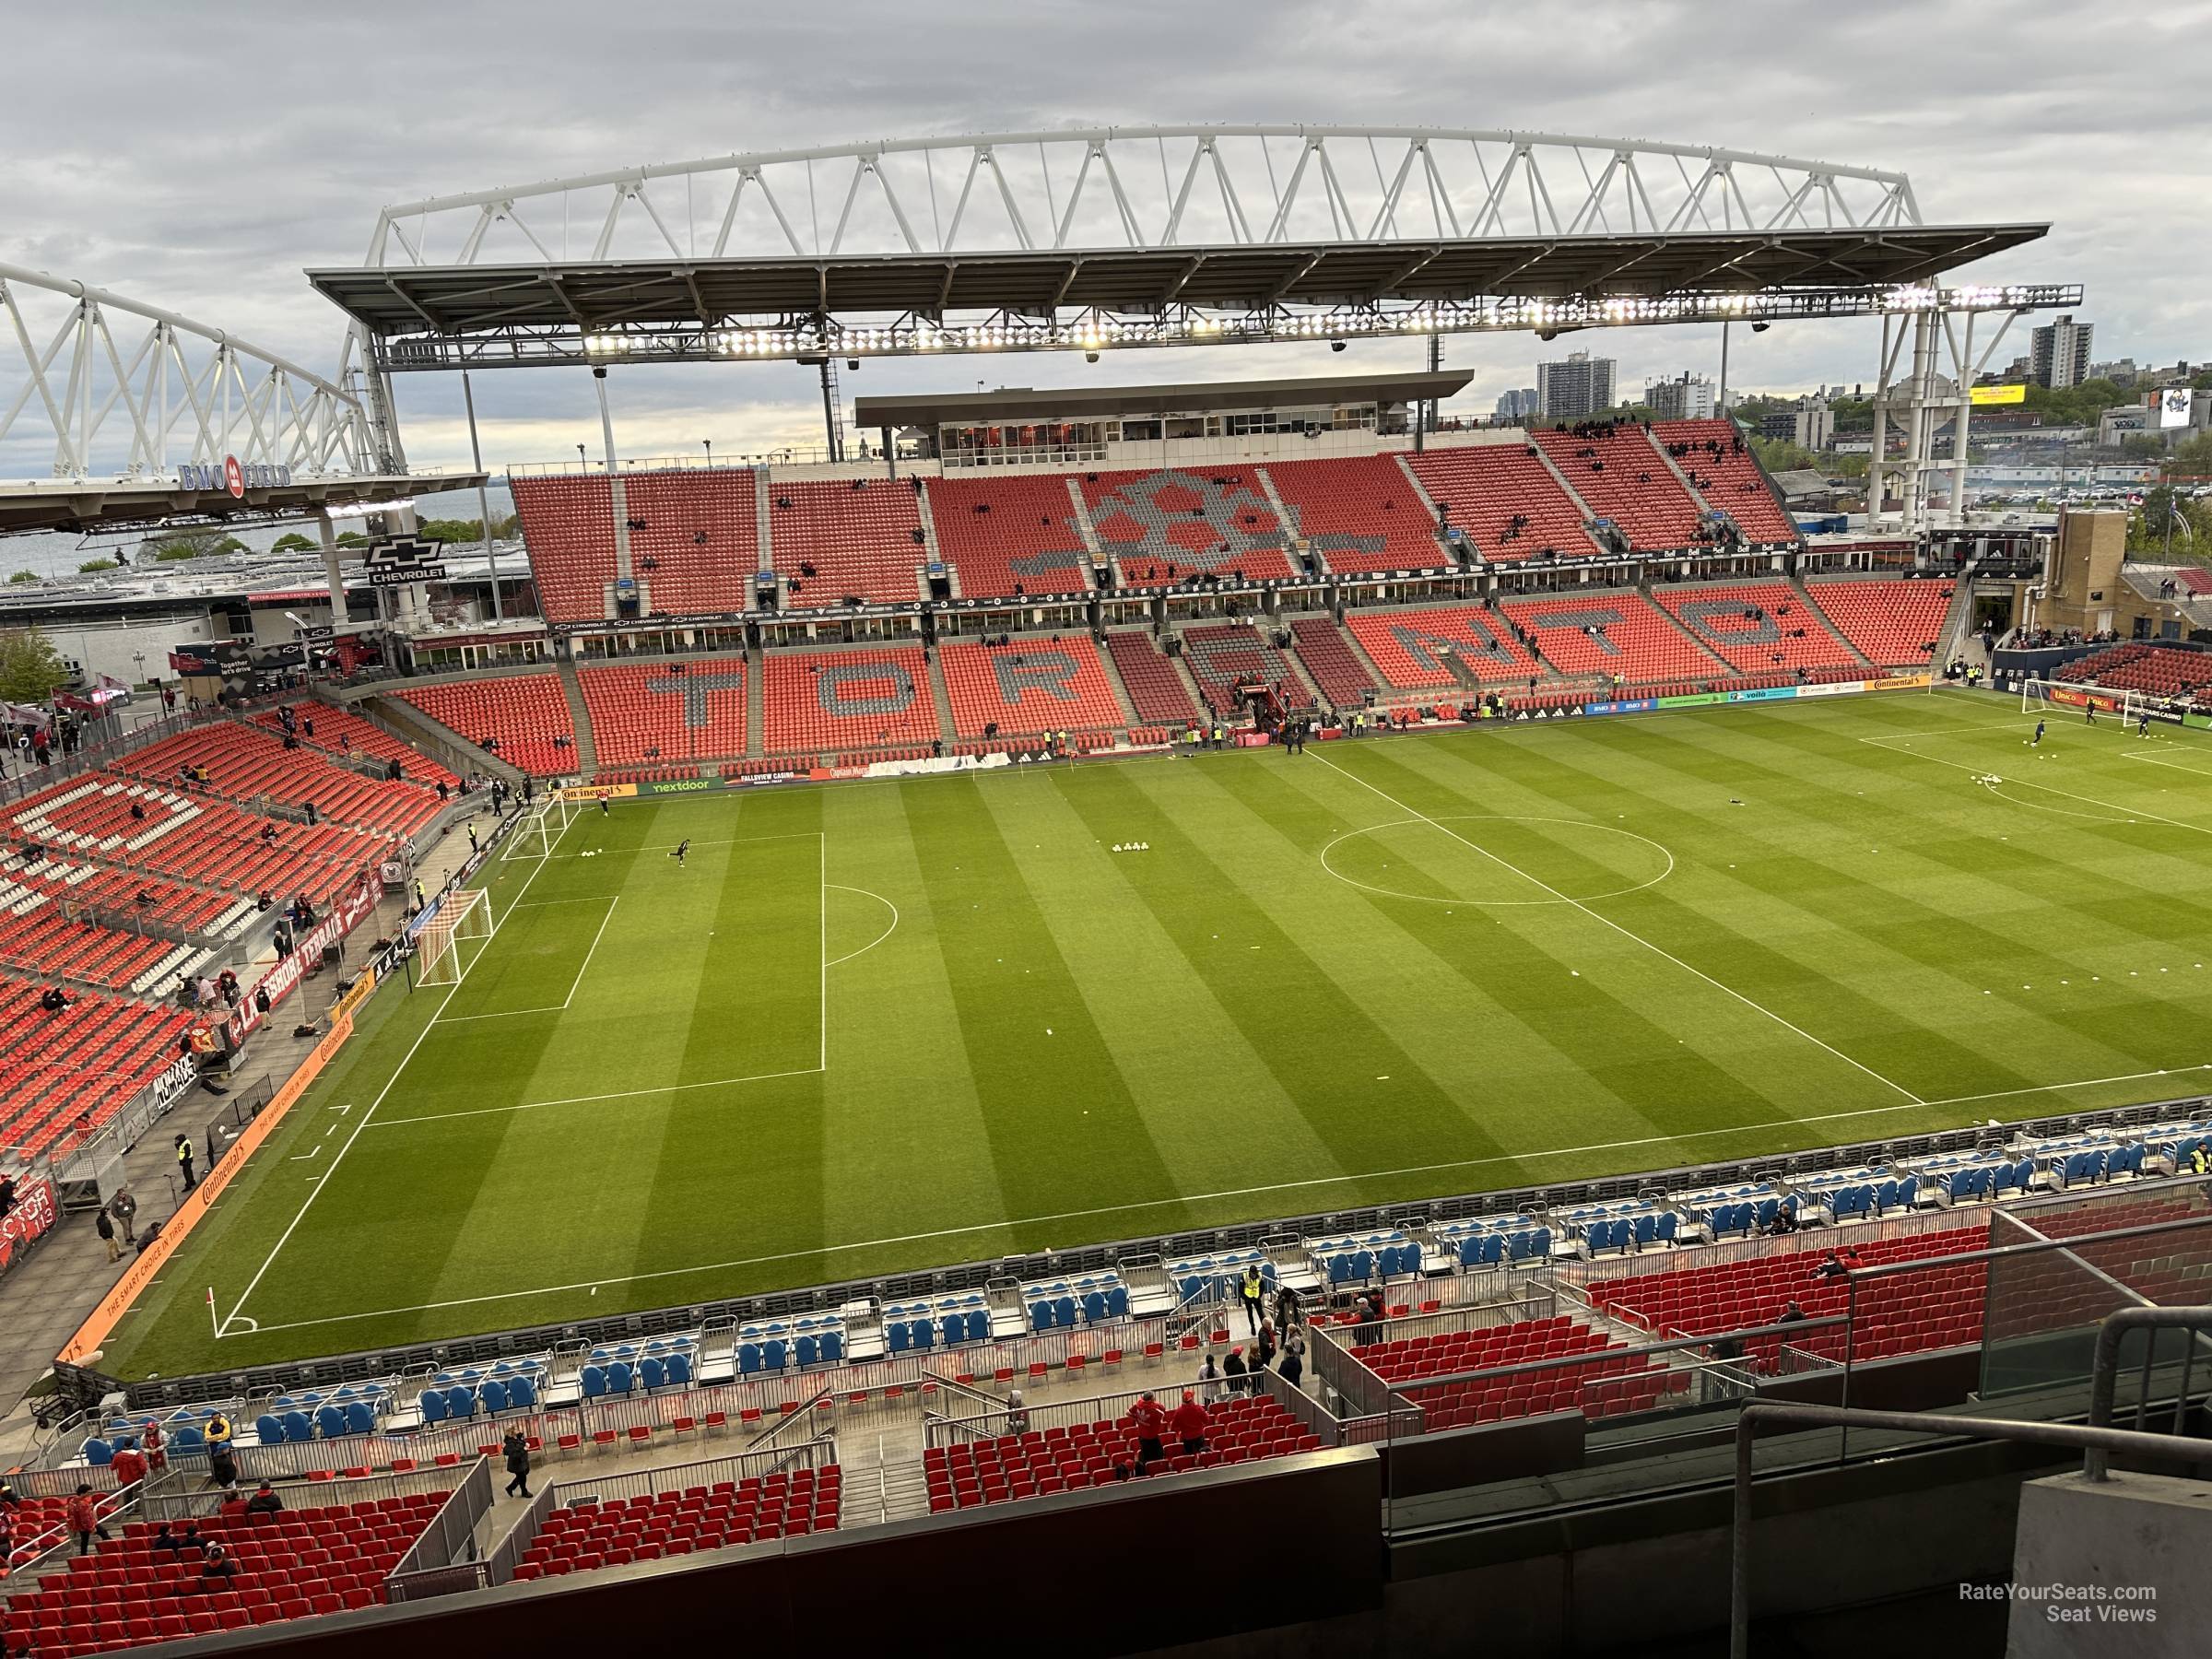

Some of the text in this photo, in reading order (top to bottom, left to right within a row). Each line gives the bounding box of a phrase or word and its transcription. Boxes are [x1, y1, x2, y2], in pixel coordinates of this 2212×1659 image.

[181, 465, 291, 490] BMO FIELD
[372, 568, 443, 583] CHEVROLET
[300, 640, 334, 650] CEVROLET
[1874, 677, 1914, 689] Continental
[2054, 690, 2077, 701] Unico
[741, 771, 794, 782] FALLSVIEW CASINO
[830, 767, 852, 779] Captain
[653, 780, 709, 793] nextdoor
[321, 1026, 347, 1062] Continental
[203, 1147, 241, 1206] Continental
[35, 1207, 53, 1233] 113
[107, 1218, 185, 1317] THE SMART CHOICE IN TIRES
